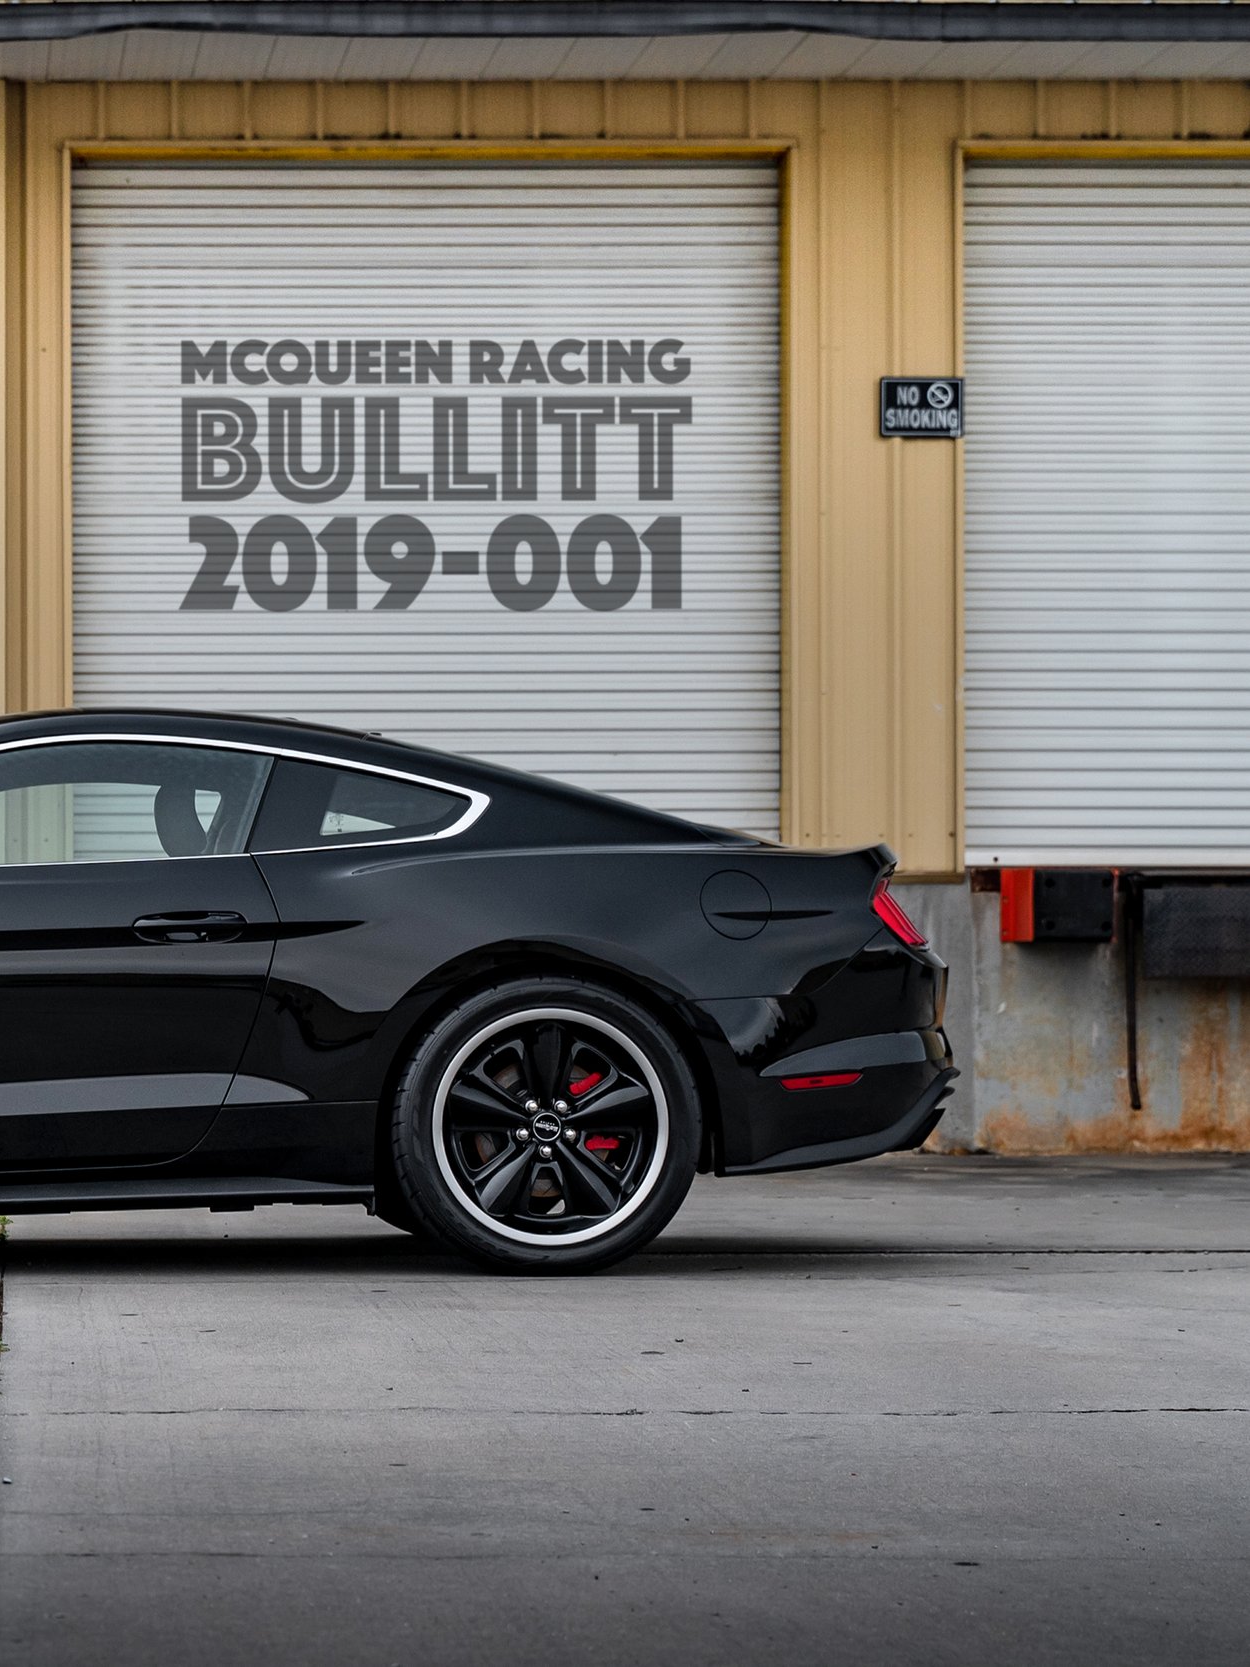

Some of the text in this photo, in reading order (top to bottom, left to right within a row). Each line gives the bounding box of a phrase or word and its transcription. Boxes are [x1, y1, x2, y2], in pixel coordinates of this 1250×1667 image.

[181, 339, 692, 385] MCQUEEN RACING
[885, 408, 958, 429] SMOKING
[896, 385, 920, 406] NO
[181, 397, 693, 504] BULLITT
[178, 513, 682, 612] 2019-001
